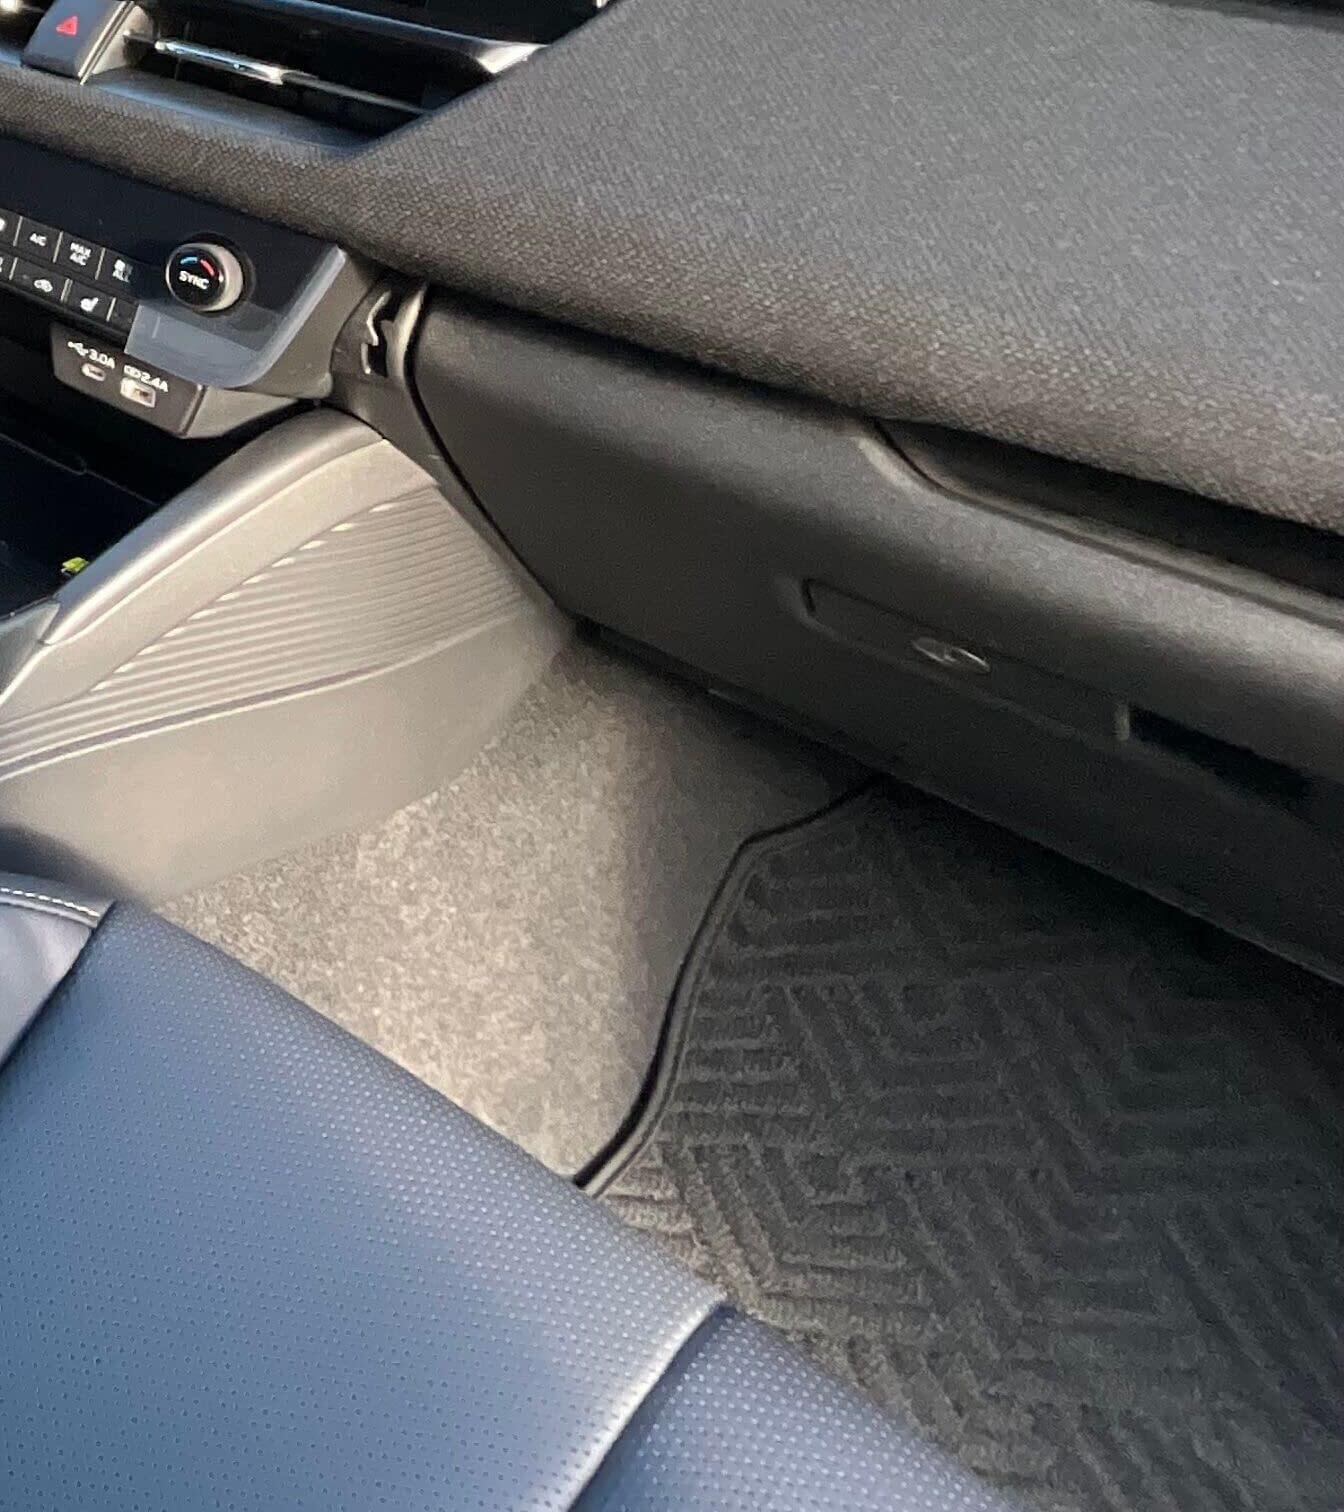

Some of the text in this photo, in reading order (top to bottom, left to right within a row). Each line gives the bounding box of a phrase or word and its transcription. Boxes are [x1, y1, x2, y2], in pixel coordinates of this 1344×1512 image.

[179, 270, 209, 290] SYNC
[87, 348, 116, 369] 3.0A
[140, 371, 169, 393] 2.4A
